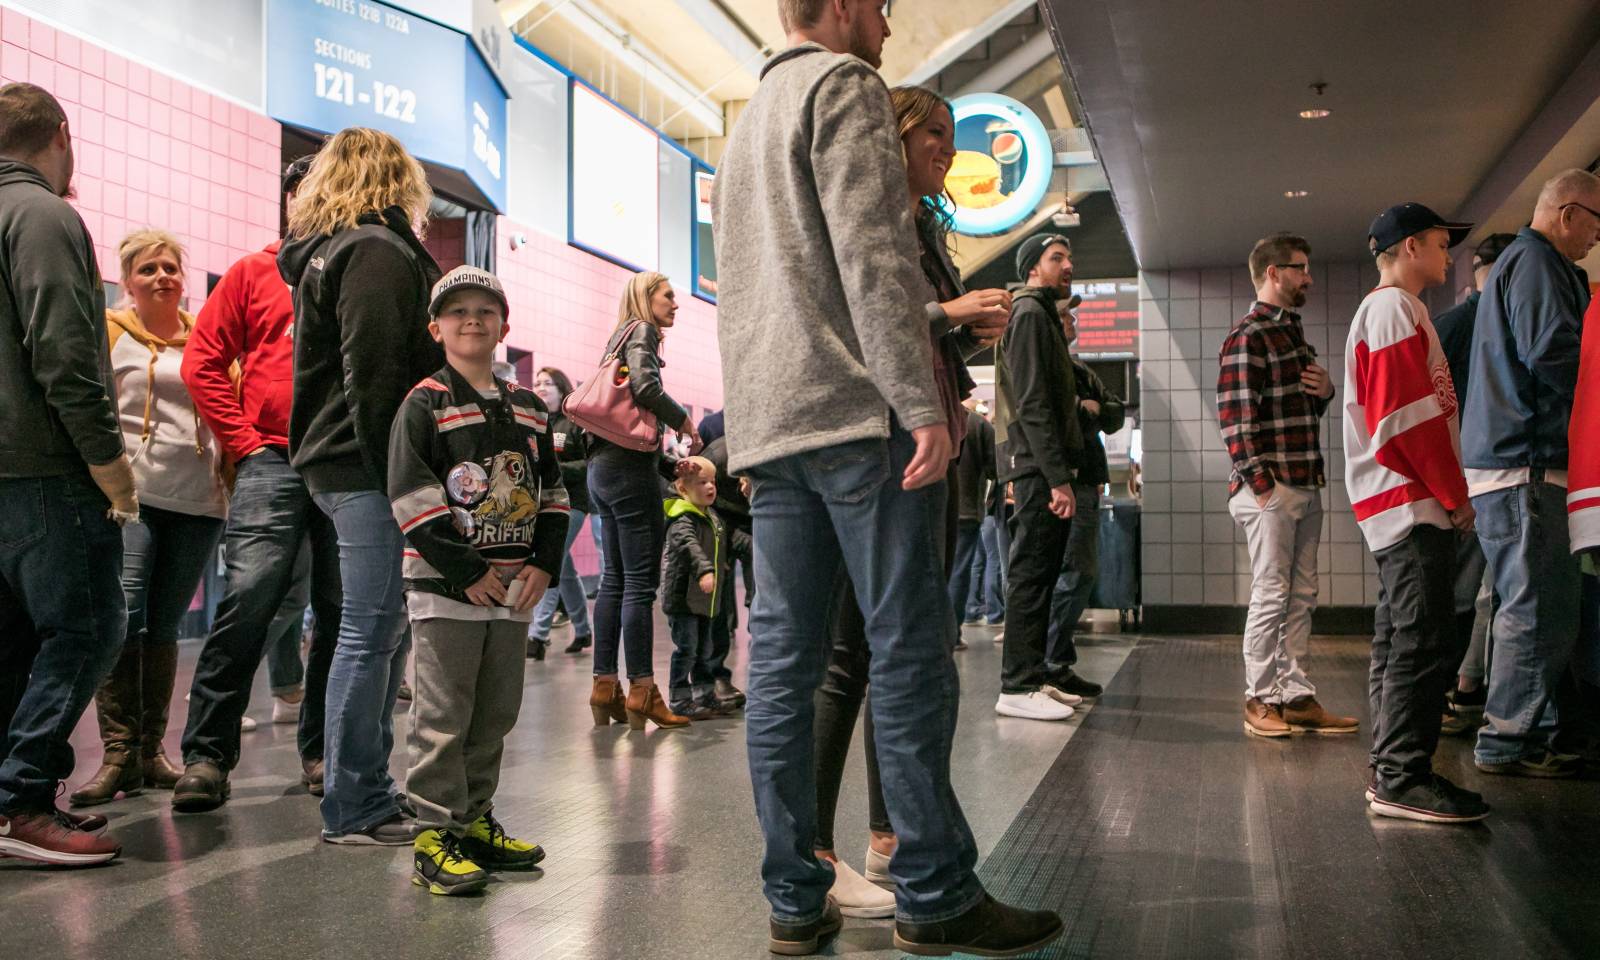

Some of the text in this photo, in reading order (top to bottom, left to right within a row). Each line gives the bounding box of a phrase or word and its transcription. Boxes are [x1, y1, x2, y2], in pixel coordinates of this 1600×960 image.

[385, 12, 410, 34] 122A
[314, 38, 372, 69] SECTIONS
[439, 274, 491, 293] CHAMPIONS
